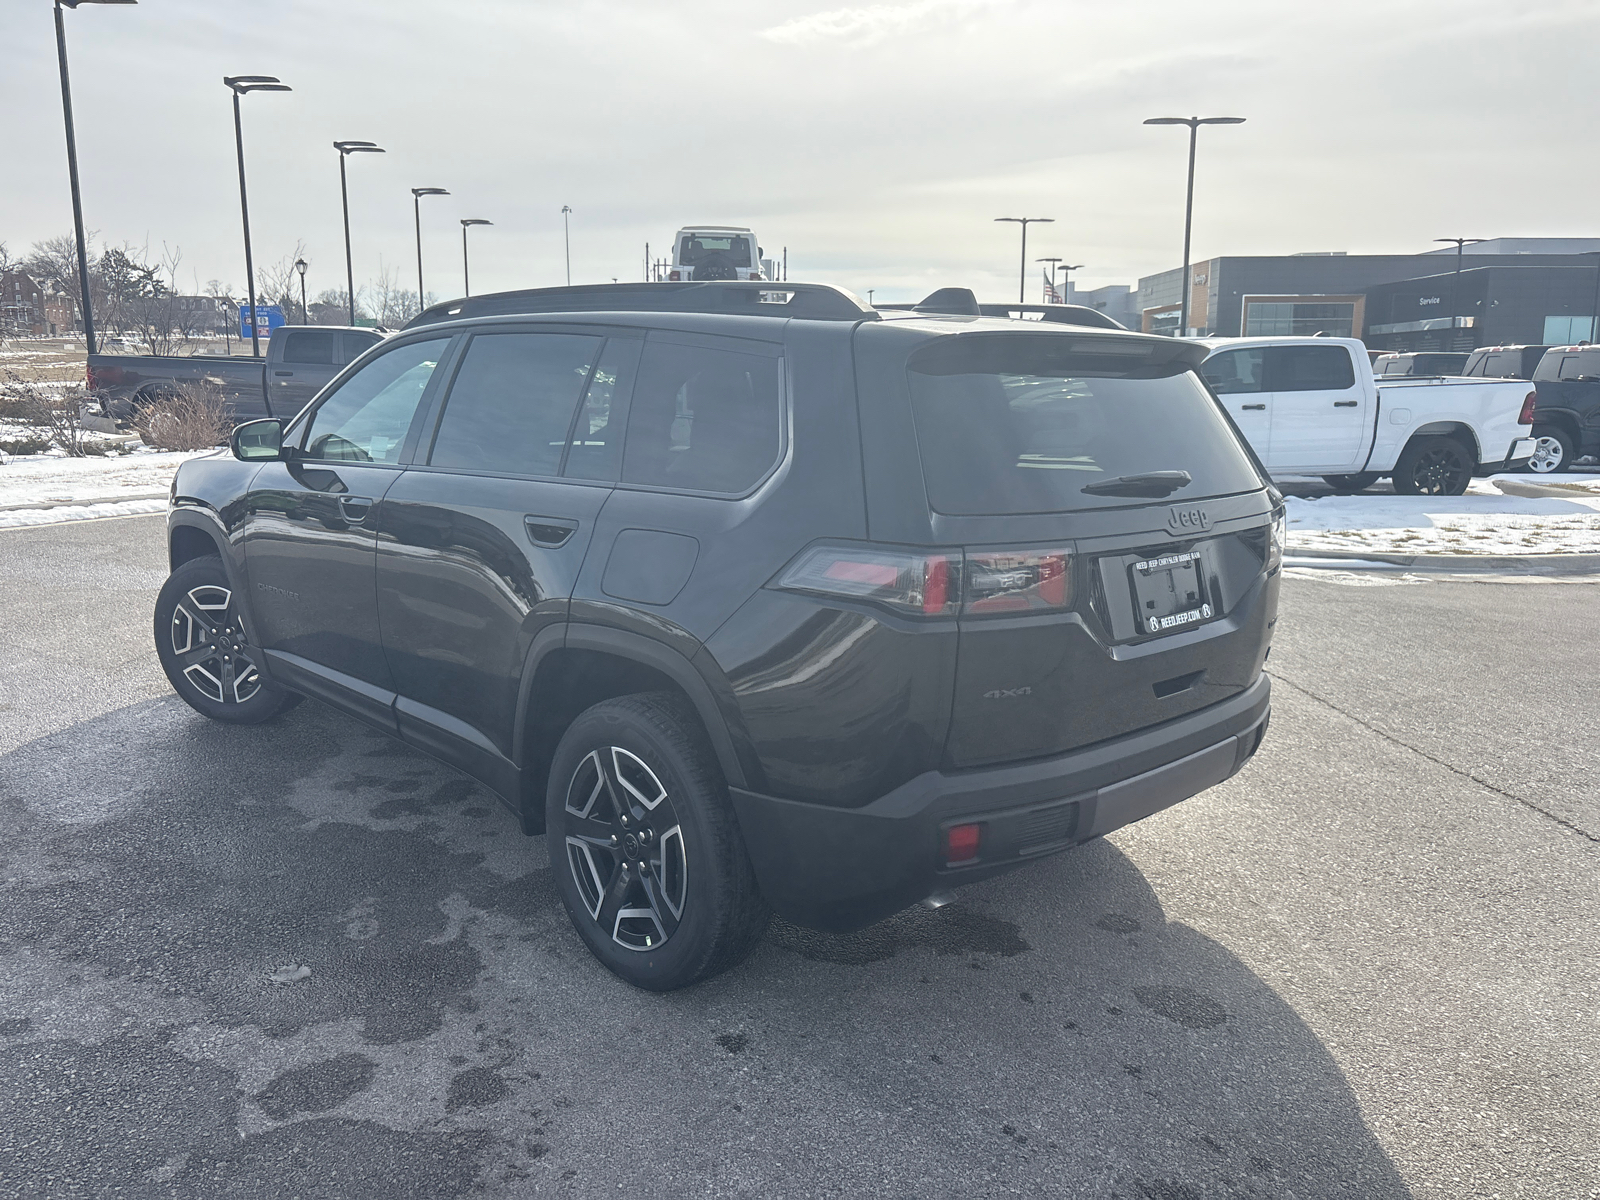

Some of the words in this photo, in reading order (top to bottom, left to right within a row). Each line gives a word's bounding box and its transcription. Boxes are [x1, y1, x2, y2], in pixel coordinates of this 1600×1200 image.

[1419, 296, 1440, 306] Service
[1168, 507, 1208, 529] Jeep
[1136, 561, 1148, 570] REED
[1148, 559, 1158, 568] JEEP
[1158, 555, 1179, 566] CHRYSLER
[1178, 553, 1191, 562] DODGE
[1190, 551, 1201, 560] RAM
[1160, 609, 1201, 629] REEDJEEP.COM
